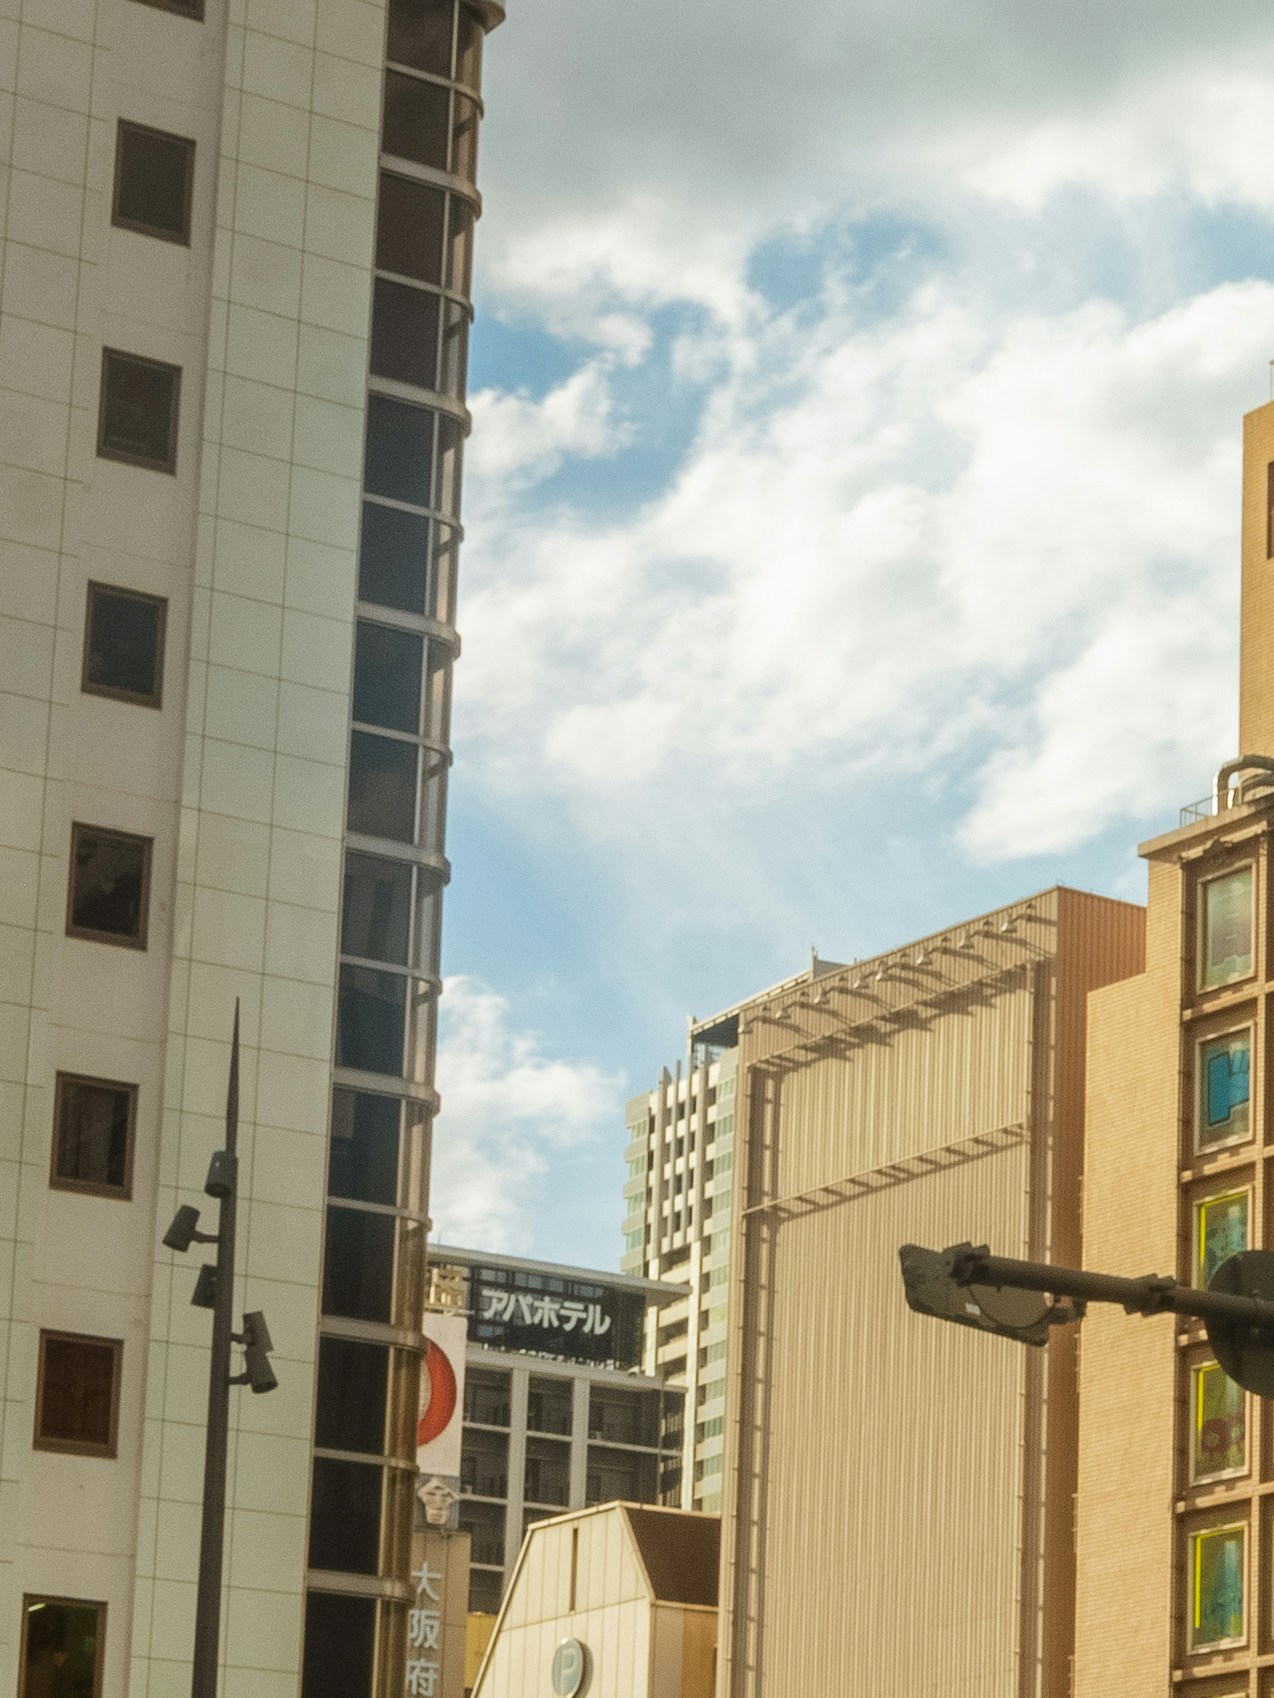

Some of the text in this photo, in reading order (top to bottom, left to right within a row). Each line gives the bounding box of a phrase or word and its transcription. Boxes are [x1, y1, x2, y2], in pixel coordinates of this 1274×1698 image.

[481, 1288, 612, 1336] アパホテル
